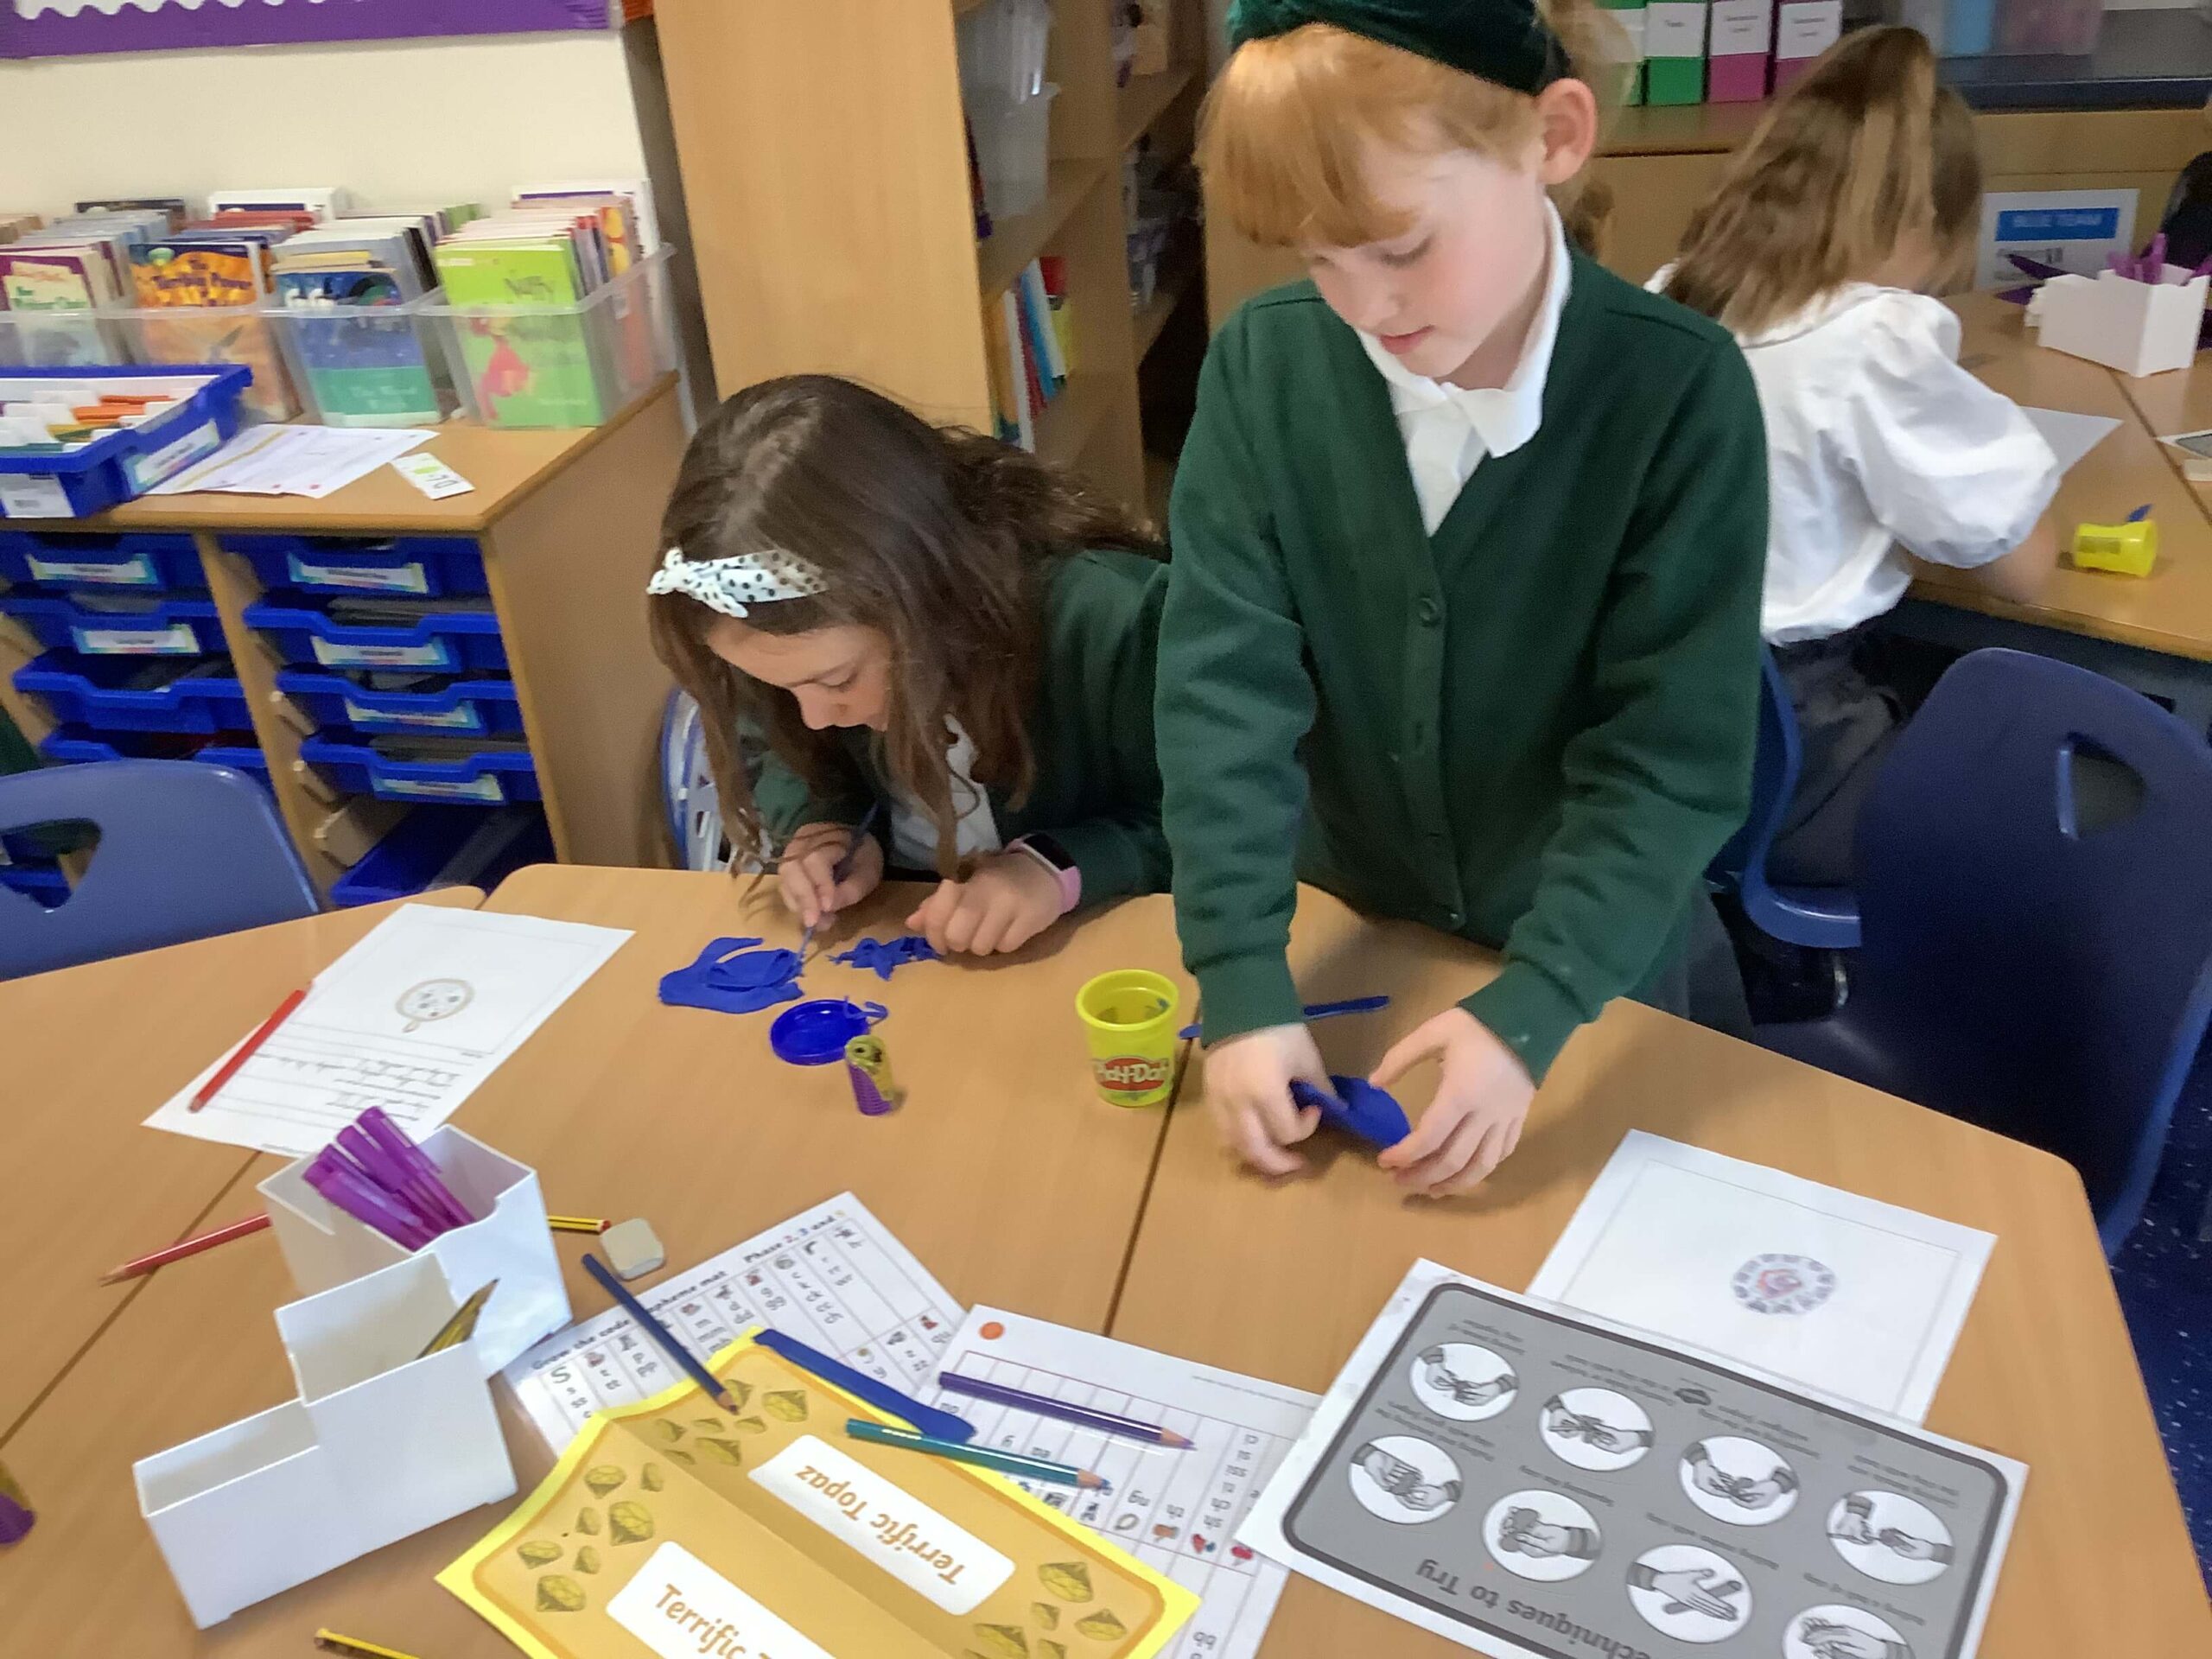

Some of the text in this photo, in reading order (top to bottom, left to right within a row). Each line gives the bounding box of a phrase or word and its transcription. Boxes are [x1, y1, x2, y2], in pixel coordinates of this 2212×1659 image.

[532, 1350, 570, 1370] Grow
[574, 1337, 596, 1349] the
[600, 1319, 631, 1337] code
[700, 1271, 727, 1287] mat
[744, 1243, 782, 1262] Phase
[811, 1216, 836, 1230] and
[796, 1465, 967, 1586] Terrific Topaz
[655, 1583, 747, 1659] Terrific
[1414, 1559, 1652, 1659] echniques to Try
